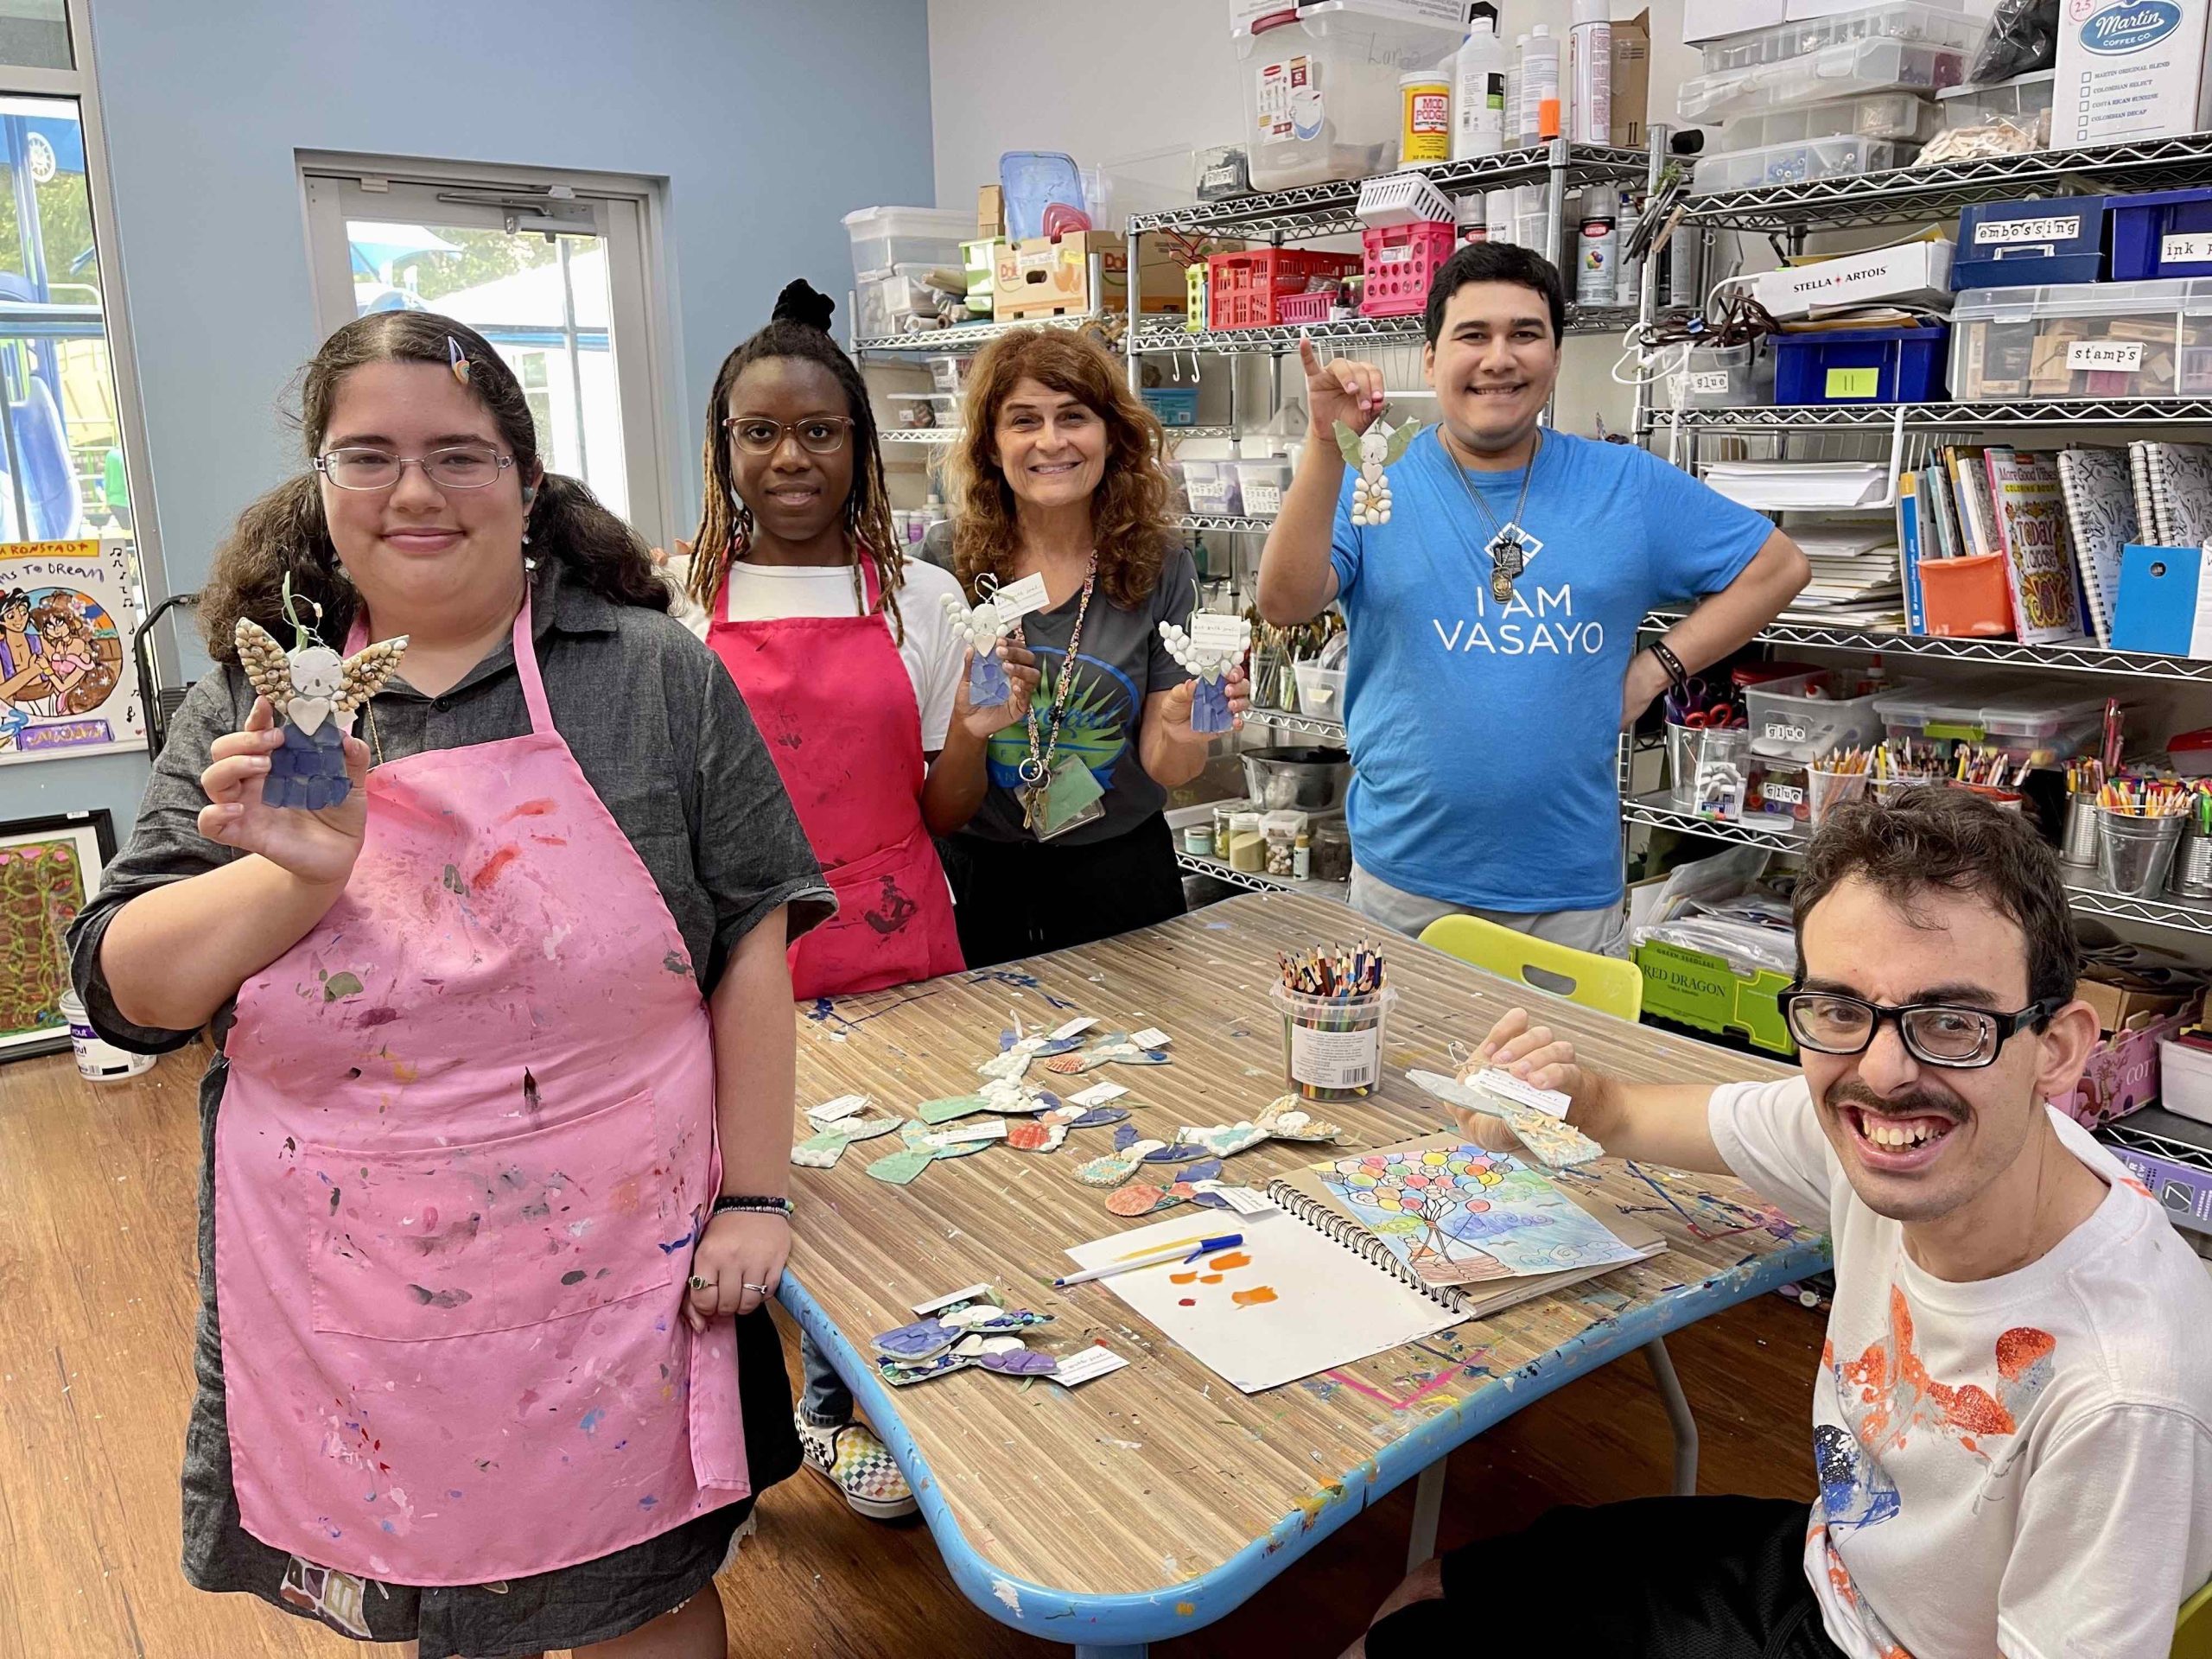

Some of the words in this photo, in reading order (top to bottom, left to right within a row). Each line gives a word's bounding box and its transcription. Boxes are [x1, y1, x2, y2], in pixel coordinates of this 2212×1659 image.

[2095, 10, 2164, 38] Martin
[2103, 36, 2136, 47] COFFEE
[2094, 70, 2117, 79] MARTIN
[2119, 66, 2149, 75] ORIGINAL
[2149, 61, 2171, 70] BLEND
[2093, 83, 2128, 94] COLOMBIAN
[2129, 79, 2153, 88] SELECT
[1422, 99, 1443, 109] MOD
[1416, 110, 1446, 121] PODGE
[2091, 113, 2126, 123] COLOMBIAN
[1980, 221, 2076, 238] embossing
[2167, 242, 2194, 257] ink
[1793, 277, 1832, 294] STELLA
[1845, 266, 1887, 283] ARTOIS
[2075, 346, 2136, 361] stamps
[1697, 376, 1725, 388] glue
[1999, 467, 2018, 480] More
[2018, 467, 2036, 481] Good
[2037, 467, 2058, 481] Vibes
[2005, 484, 2035, 493] COLORING
[2037, 484, 2057, 493] BOOK
[1477, 587, 1484, 617] I
[1502, 584, 1572, 620] AM
[1433, 620, 1604, 655] VASAYO
[1769, 727, 1805, 738] glue
[1767, 786, 1799, 800] glue
[1656, 949, 1679, 959] GREEN
[1680, 953, 1714, 969] SEEDLESS
[1643, 964, 1668, 981] RED
[1671, 971, 1726, 996] DRAGON
[2164, 1185, 2191, 1205] 7
[2196, 1190, 2206, 1217] PERSONAL
